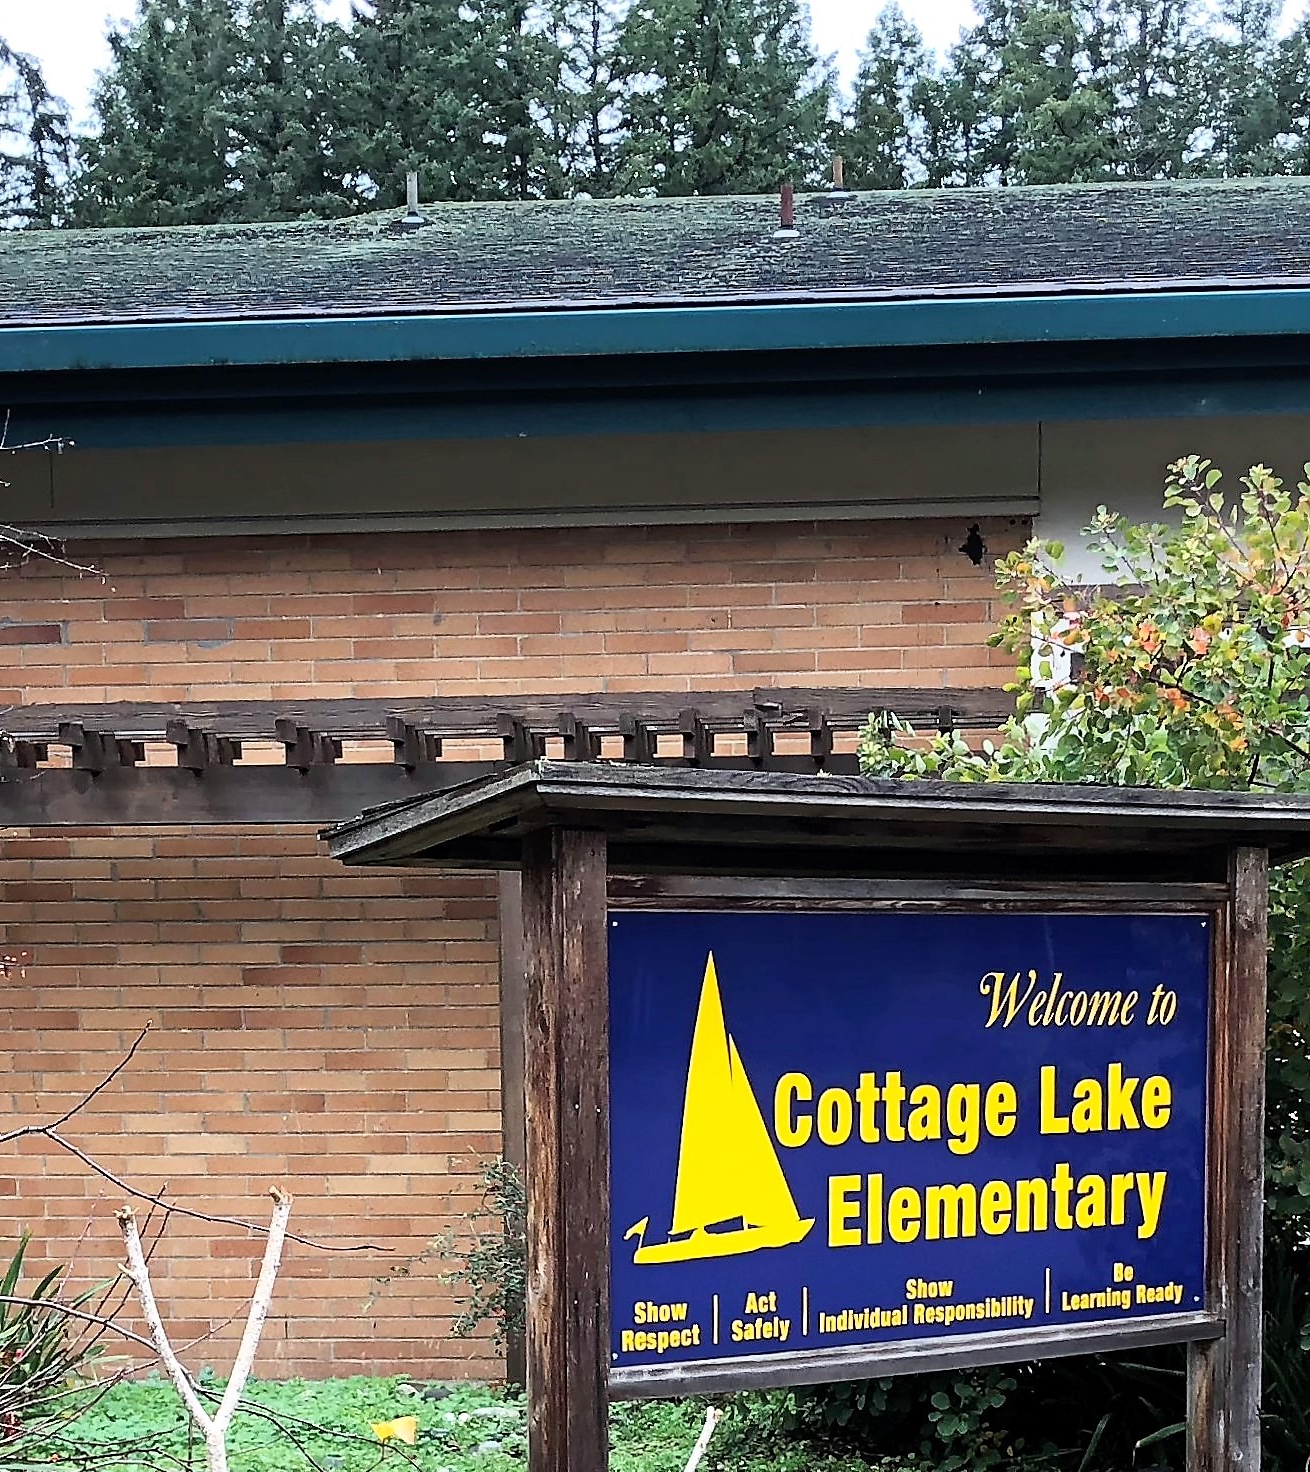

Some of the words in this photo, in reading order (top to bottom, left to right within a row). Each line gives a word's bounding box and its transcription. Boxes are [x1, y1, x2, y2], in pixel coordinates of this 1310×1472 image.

[979, 969, 1138, 1028] Welcome
[1146, 983, 1177, 1026] to
[774, 1070, 1017, 1155] Cottage
[1039, 1062, 1172, 1135] Lake
[828, 1162, 1167, 1248] Elementary
[1113, 1262, 1133, 1282] Be
[744, 1291, 777, 1314] Act
[905, 1278, 954, 1300] Show
[1061, 1286, 1132, 1312] Learning
[1135, 1281, 1184, 1305] Ready
[633, 1300, 688, 1324] Show
[818, 1304, 907, 1333] Individual
[912, 1295, 1034, 1325] Responsibility
[621, 1324, 700, 1354] Respect
[731, 1316, 791, 1342] Safely
